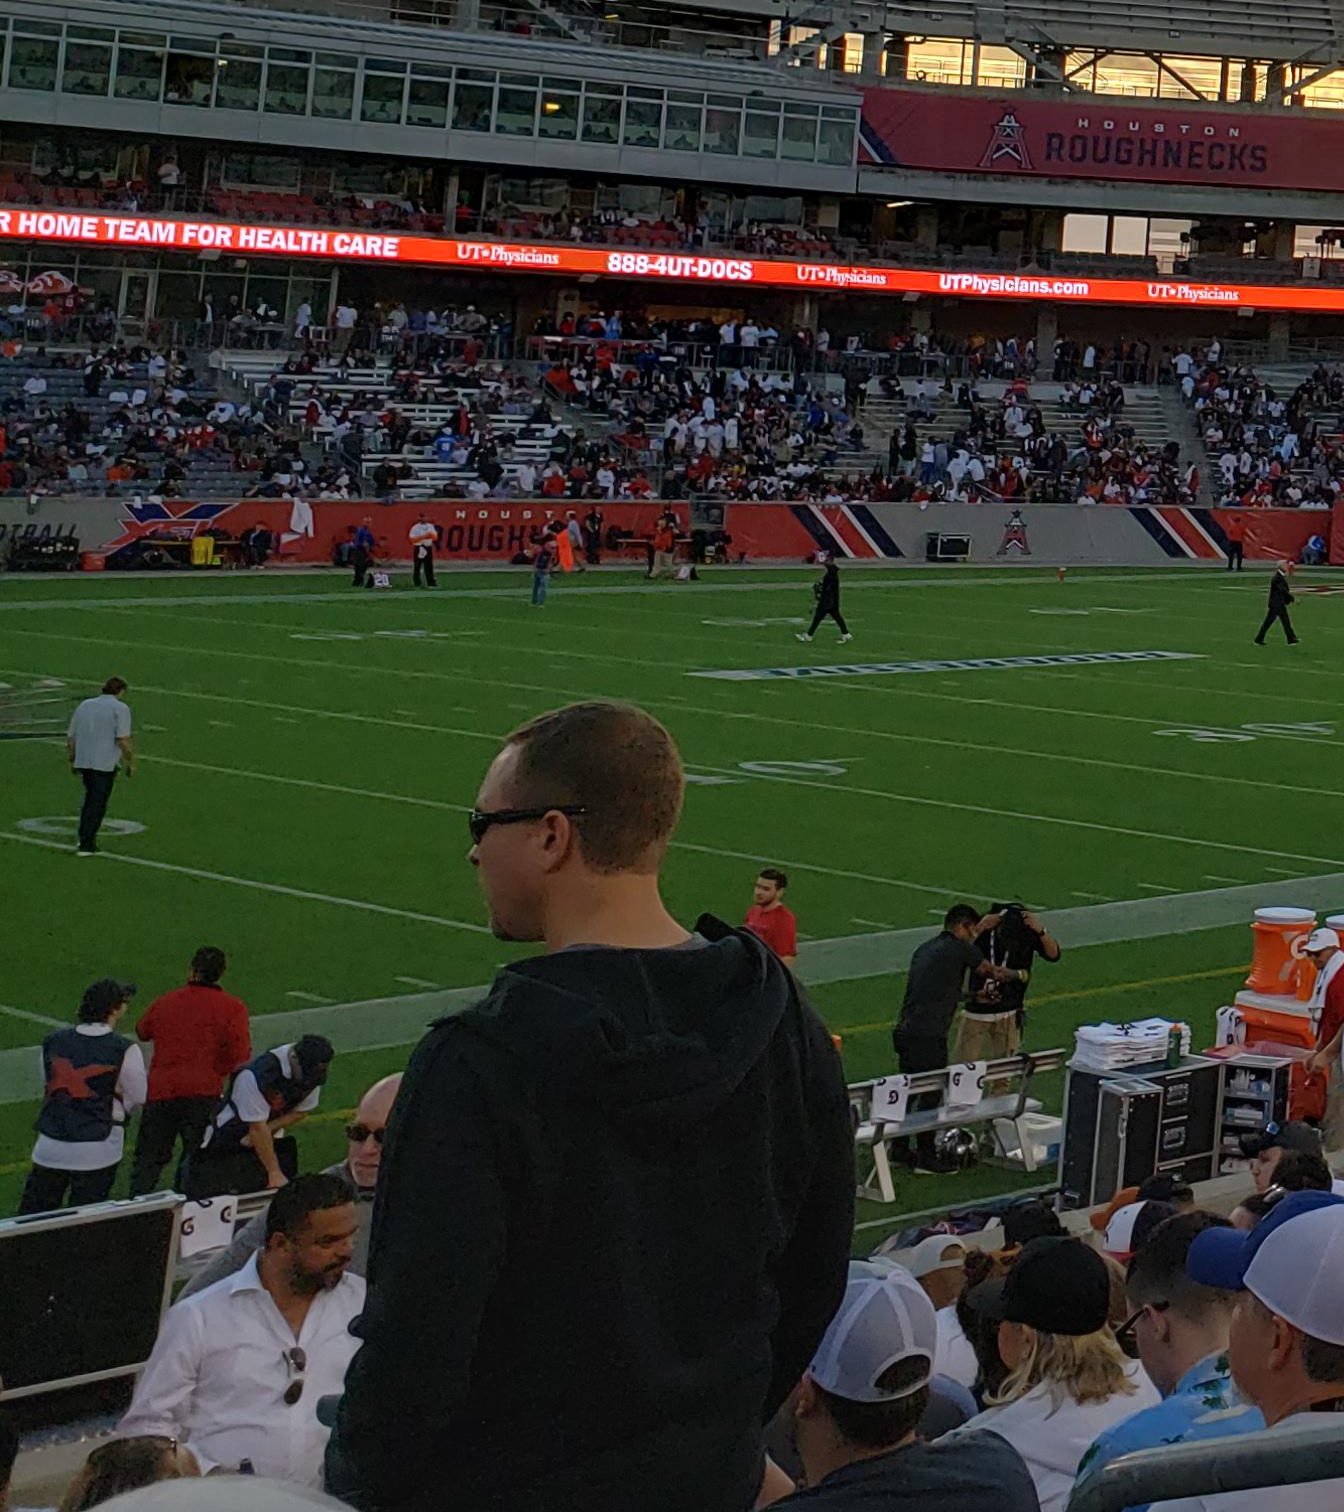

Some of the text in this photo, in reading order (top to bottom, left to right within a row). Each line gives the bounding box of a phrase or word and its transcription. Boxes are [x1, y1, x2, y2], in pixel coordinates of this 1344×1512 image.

[1077, 118, 1239, 137] HOUSTON
[1044, 131, 1269, 173] ROUGHNECKS
[19, 214, 97, 238] HOME
[104, 218, 175, 243] TEAM
[183, 224, 232, 247] FOR
[239, 228, 327, 252] HEALTH
[334, 233, 399, 256] CARE
[607, 254, 752, 280] 888-4UT-DOCS
[940, 273, 1089, 296] UTPhysicians.com
